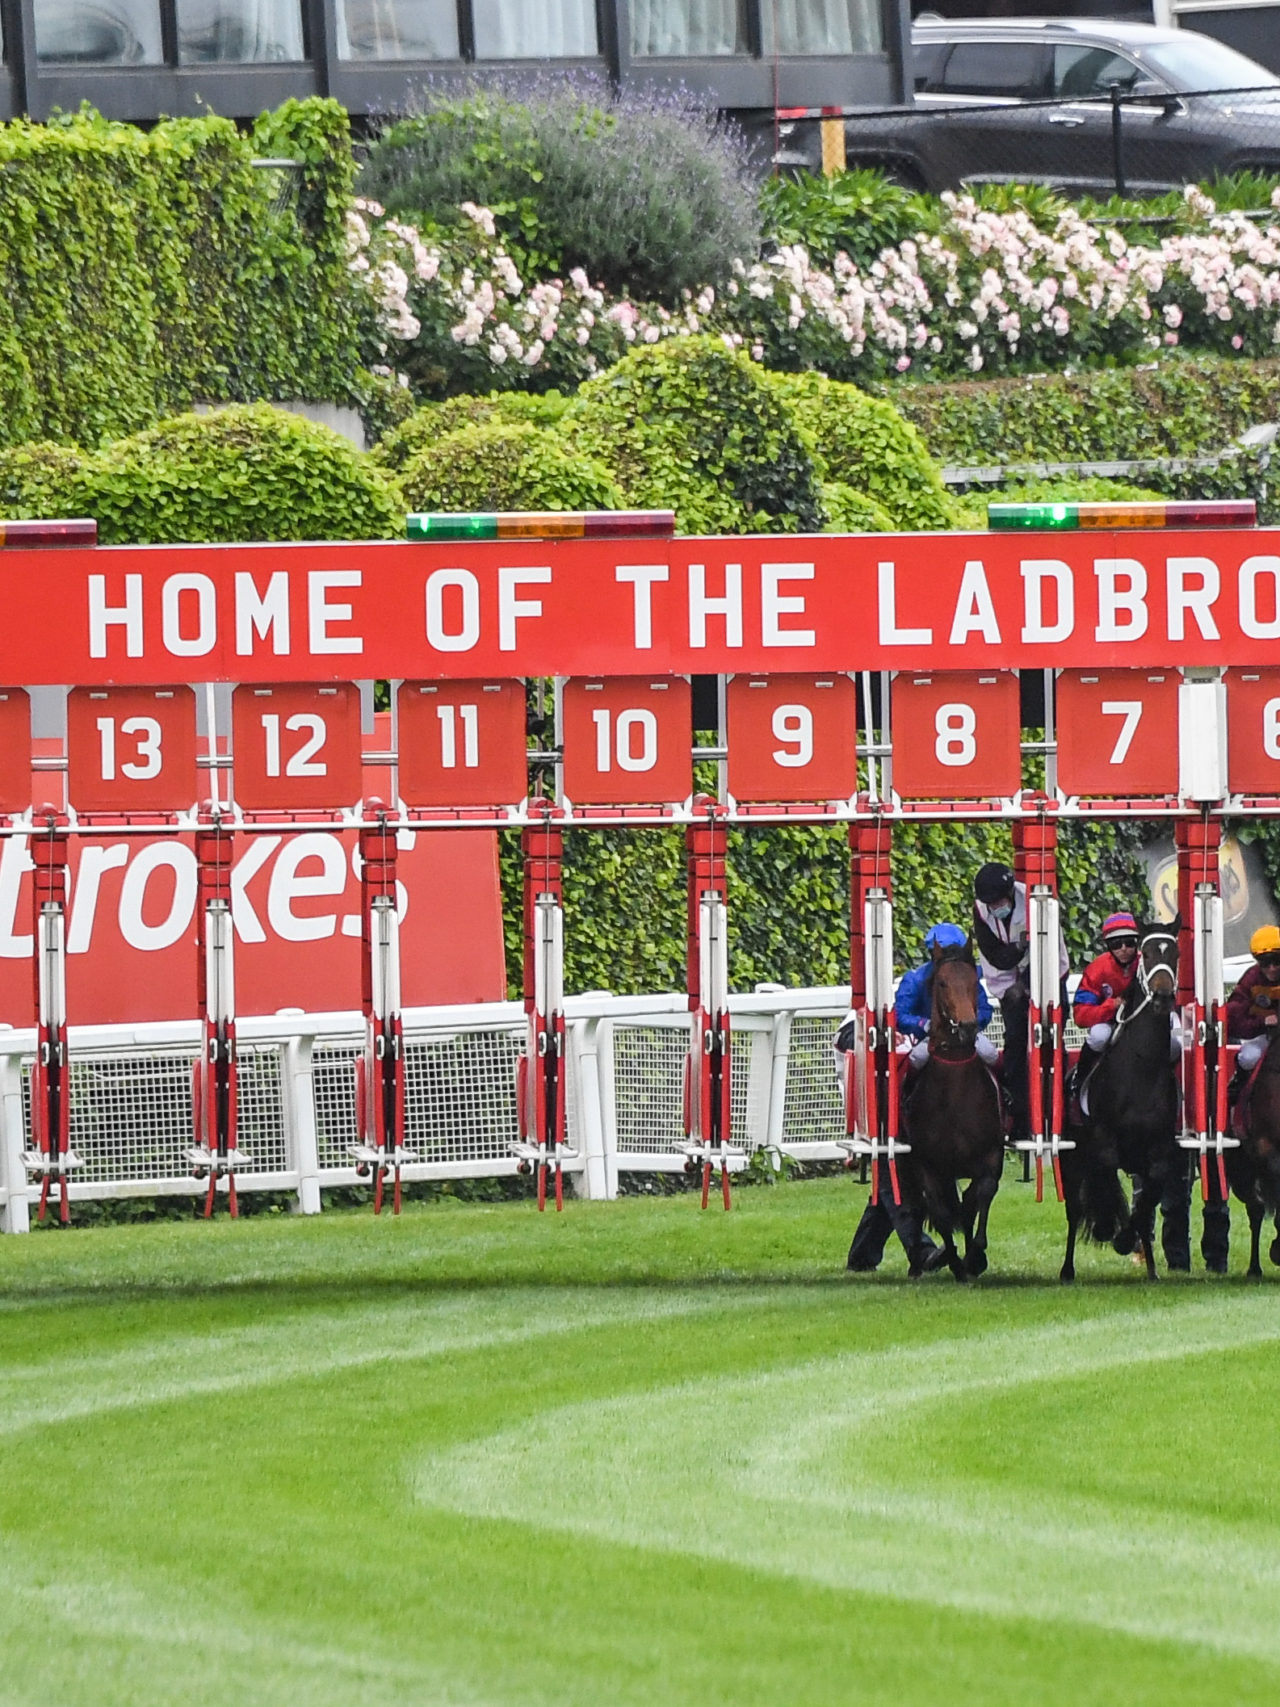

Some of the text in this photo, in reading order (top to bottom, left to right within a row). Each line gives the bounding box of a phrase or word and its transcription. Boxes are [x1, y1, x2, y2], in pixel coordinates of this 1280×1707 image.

[87, 568, 365, 659] HOME
[424, 565, 554, 653] OF
[614, 561, 818, 650] THE
[96, 716, 163, 780] 13
[260, 713, 328, 777] 12
[436, 704, 480, 768] 11
[592, 707, 658, 772] 10
[771, 703, 815, 769] 9
[934, 702, 978, 768] 8
[1100, 699, 1144, 765] 7
